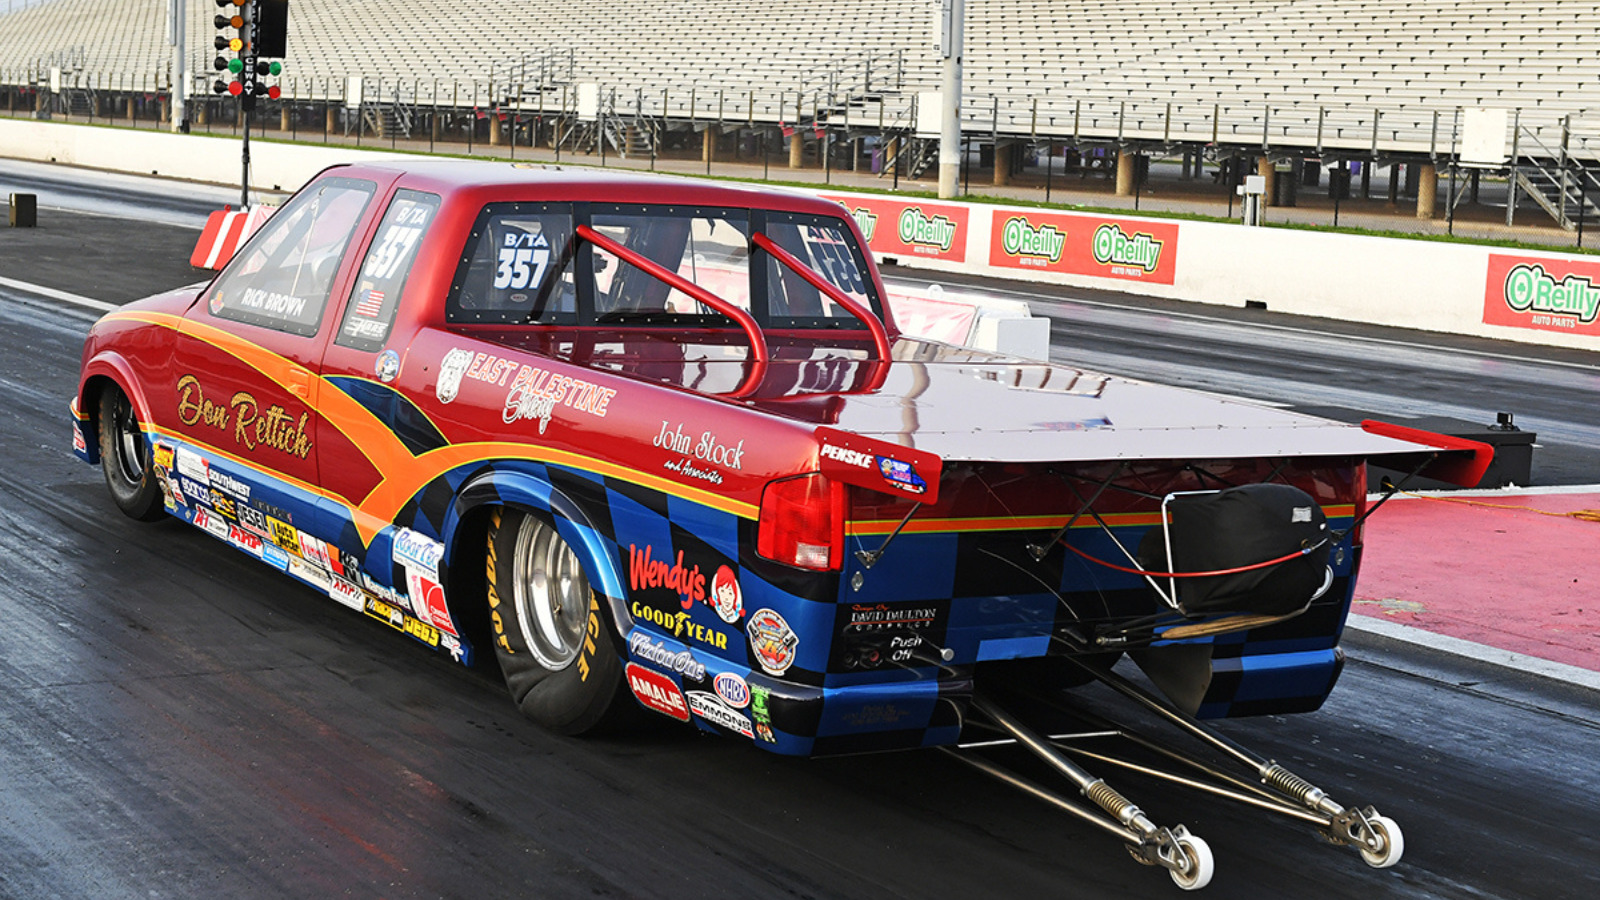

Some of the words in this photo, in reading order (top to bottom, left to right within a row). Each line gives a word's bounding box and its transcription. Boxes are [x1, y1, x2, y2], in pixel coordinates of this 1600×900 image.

[396, 207, 429, 225] B/TA
[900, 209, 955, 248] O'Reilly
[364, 226, 423, 279] 357
[504, 233, 549, 248] B/TA
[1004, 219, 1065, 260] O'Reilly
[1095, 227, 1161, 269] O'Reilly
[493, 248, 550, 290] 357
[241, 288, 265, 308] RICK
[265, 292, 307, 317] BROWN
[1507, 268, 1600, 319] O'Reilly
[1532, 315, 1551, 326] AUTO
[1552, 317, 1576, 328] PARTS
[466, 352, 518, 387] EAST
[511, 365, 617, 417] PALESTINE
[177, 373, 230, 431] Don
[230, 391, 313, 460] Rettich
[653, 420, 692, 455] John
[695, 431, 745, 470] Stock
[820, 443, 874, 469] PENSKE
[629, 543, 706, 609] Wendy's
[851, 611, 884, 622] DAVID
[886, 608, 937, 620] DAULTON
[890, 636, 923, 648] Push
[631, 675, 686, 713] AMALIE
[717, 677, 747, 703] NHRA
[690, 696, 752, 731] EMMONS
